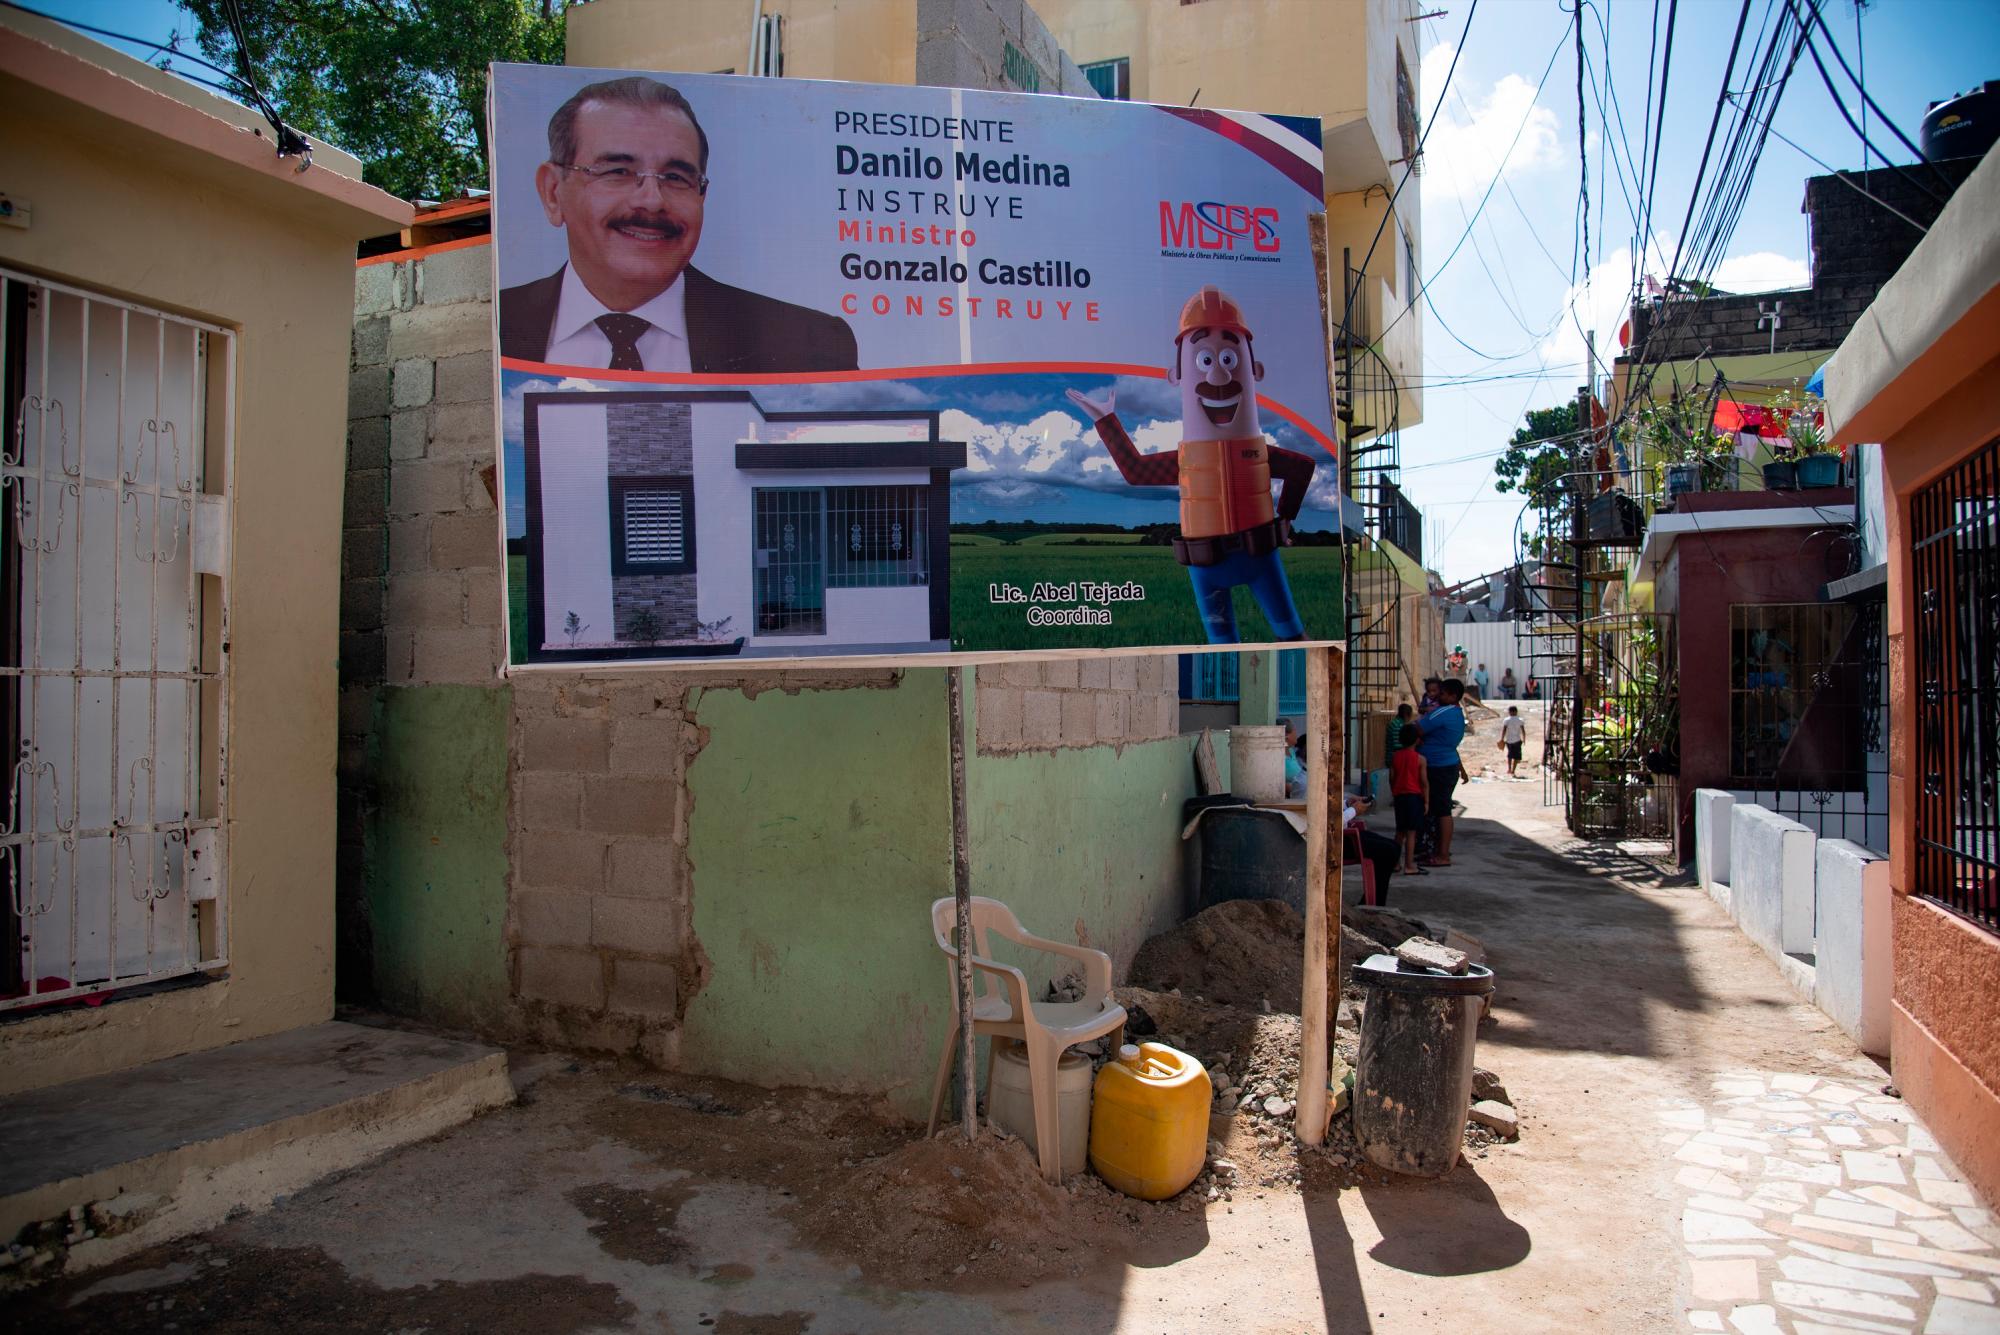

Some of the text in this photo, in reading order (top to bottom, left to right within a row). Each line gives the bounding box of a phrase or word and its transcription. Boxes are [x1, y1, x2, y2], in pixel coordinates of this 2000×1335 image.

[835, 111, 1014, 143] PRESIDENTE
[836, 145, 1071, 188] Danilo Medina
[837, 188, 1023, 219] INSTRUYE
[838, 219, 977, 247] Ministro
[1160, 200, 1280, 252] MOPC
[840, 253, 1092, 289] Gonzalo Castillo
[1160, 249, 1188, 259] Ministerio
[1188, 251, 1196, 259] de
[1195, 251, 1212, 260] Obras
[1239, 254, 1280, 263] Comunicaciones
[841, 293, 1100, 322] CONSTRUYE
[990, 581, 1145, 604] Lic. Abel Tejada
[1028, 606, 1112, 626] Coordina
